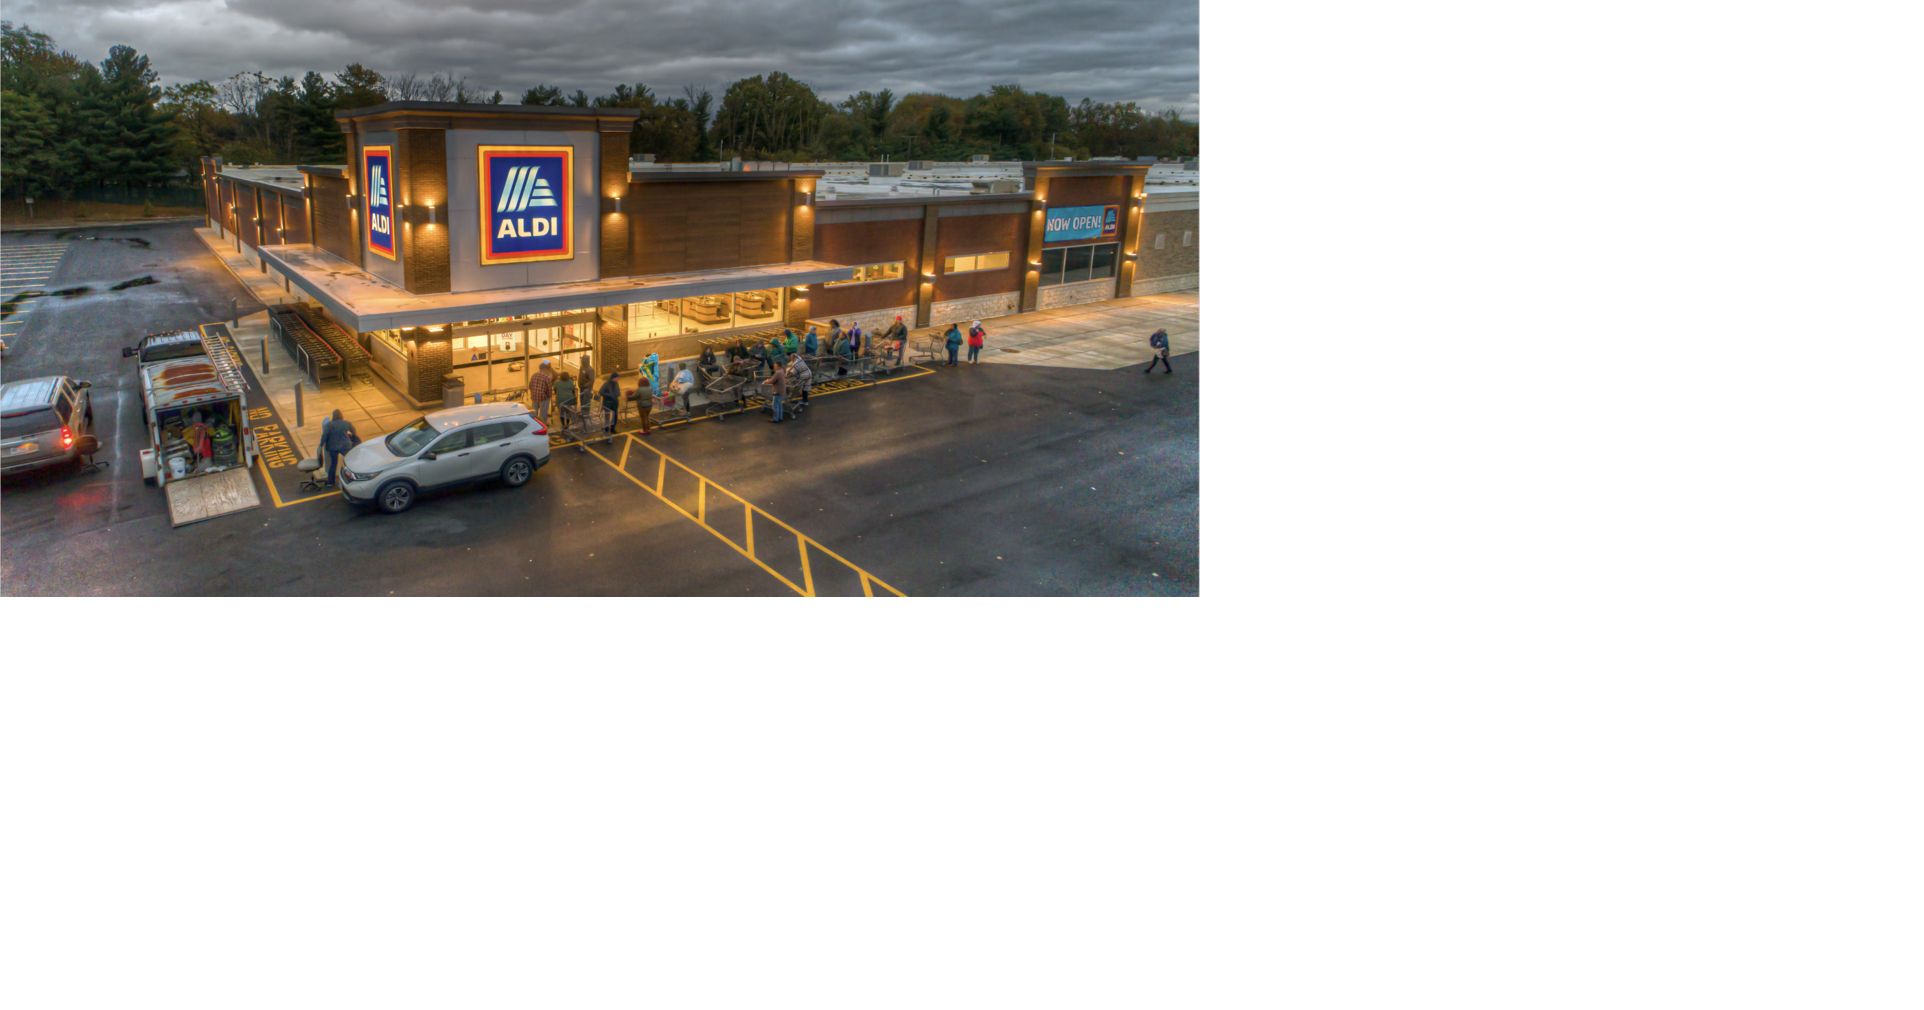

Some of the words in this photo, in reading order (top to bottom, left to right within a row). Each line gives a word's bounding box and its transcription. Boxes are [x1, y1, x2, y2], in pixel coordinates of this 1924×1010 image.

[372, 213, 390, 234] ALDI
[497, 217, 558, 239] ALDI
[1047, 217, 1071, 232] NOW
[1072, 215, 1102, 230] OPEN!
[247, 407, 272, 420] NO
[253, 423, 298, 468] PARKING
